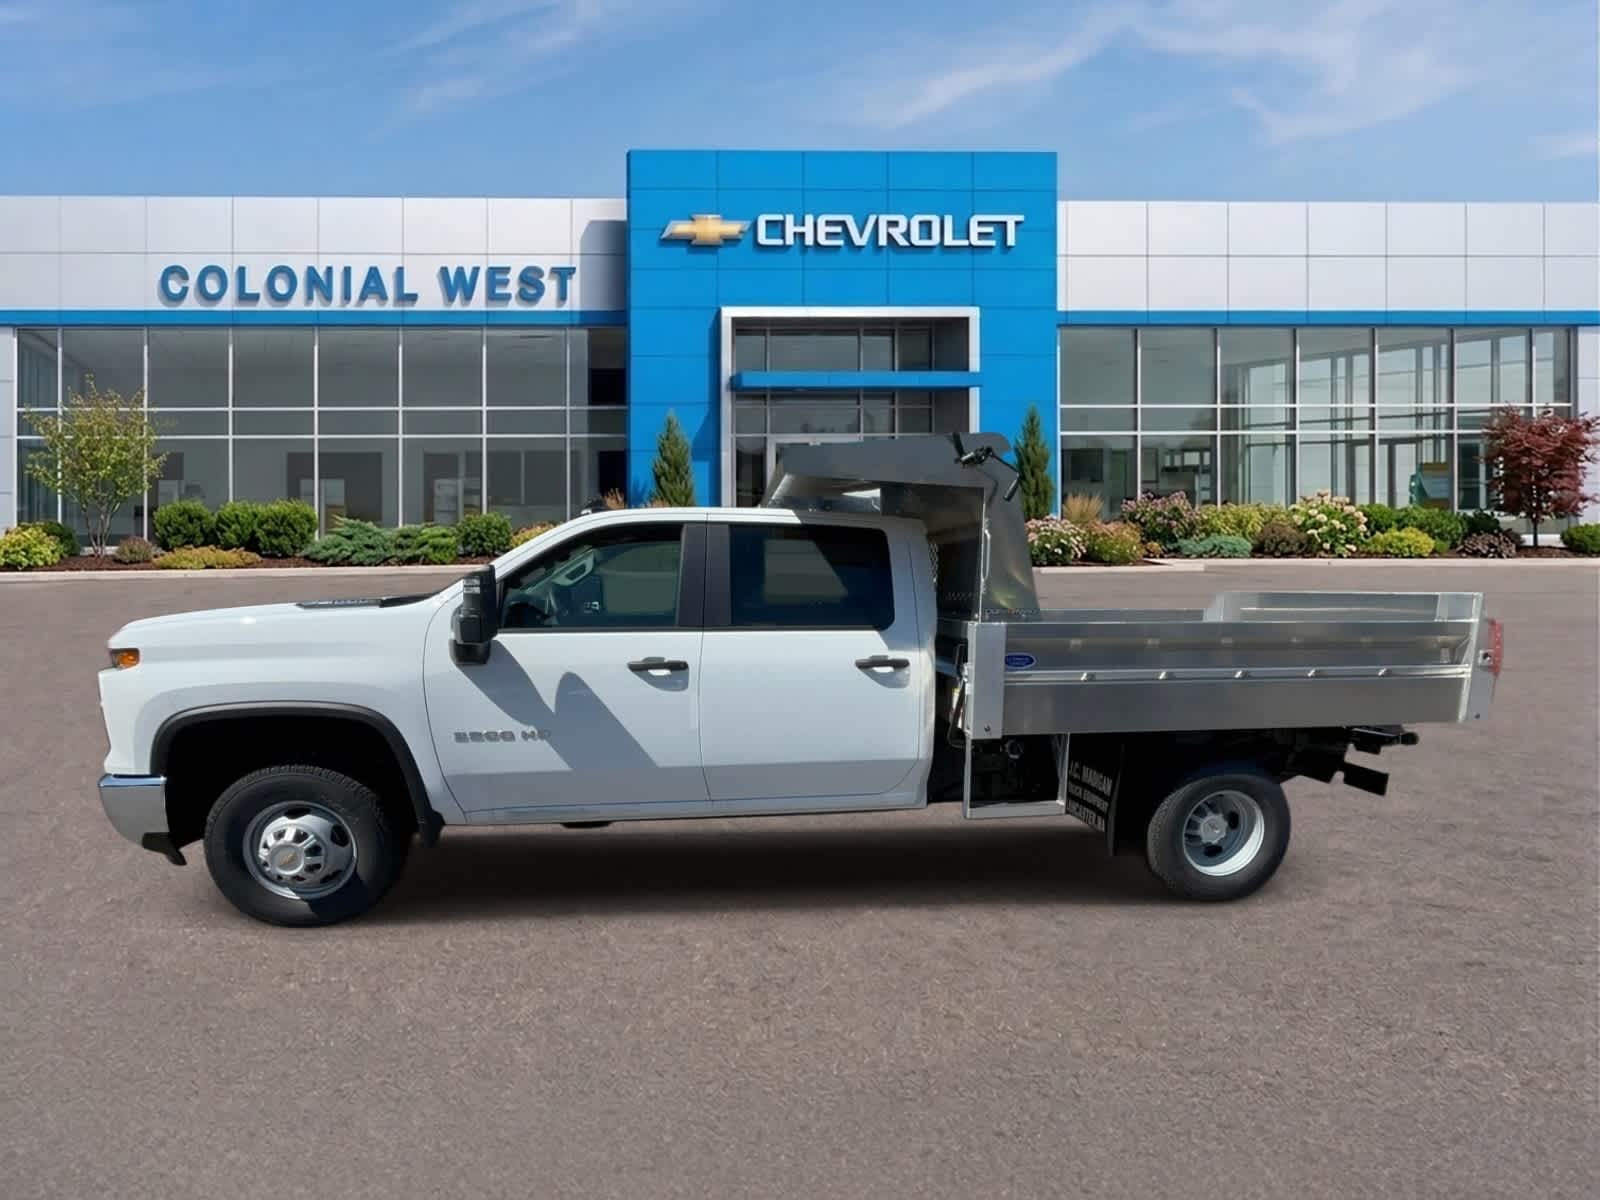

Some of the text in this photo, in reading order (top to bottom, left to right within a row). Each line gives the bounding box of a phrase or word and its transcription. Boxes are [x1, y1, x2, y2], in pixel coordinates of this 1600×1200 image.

[755, 213, 1025, 247] CHEVROLET
[159, 264, 577, 305] COLONIAL WEST
